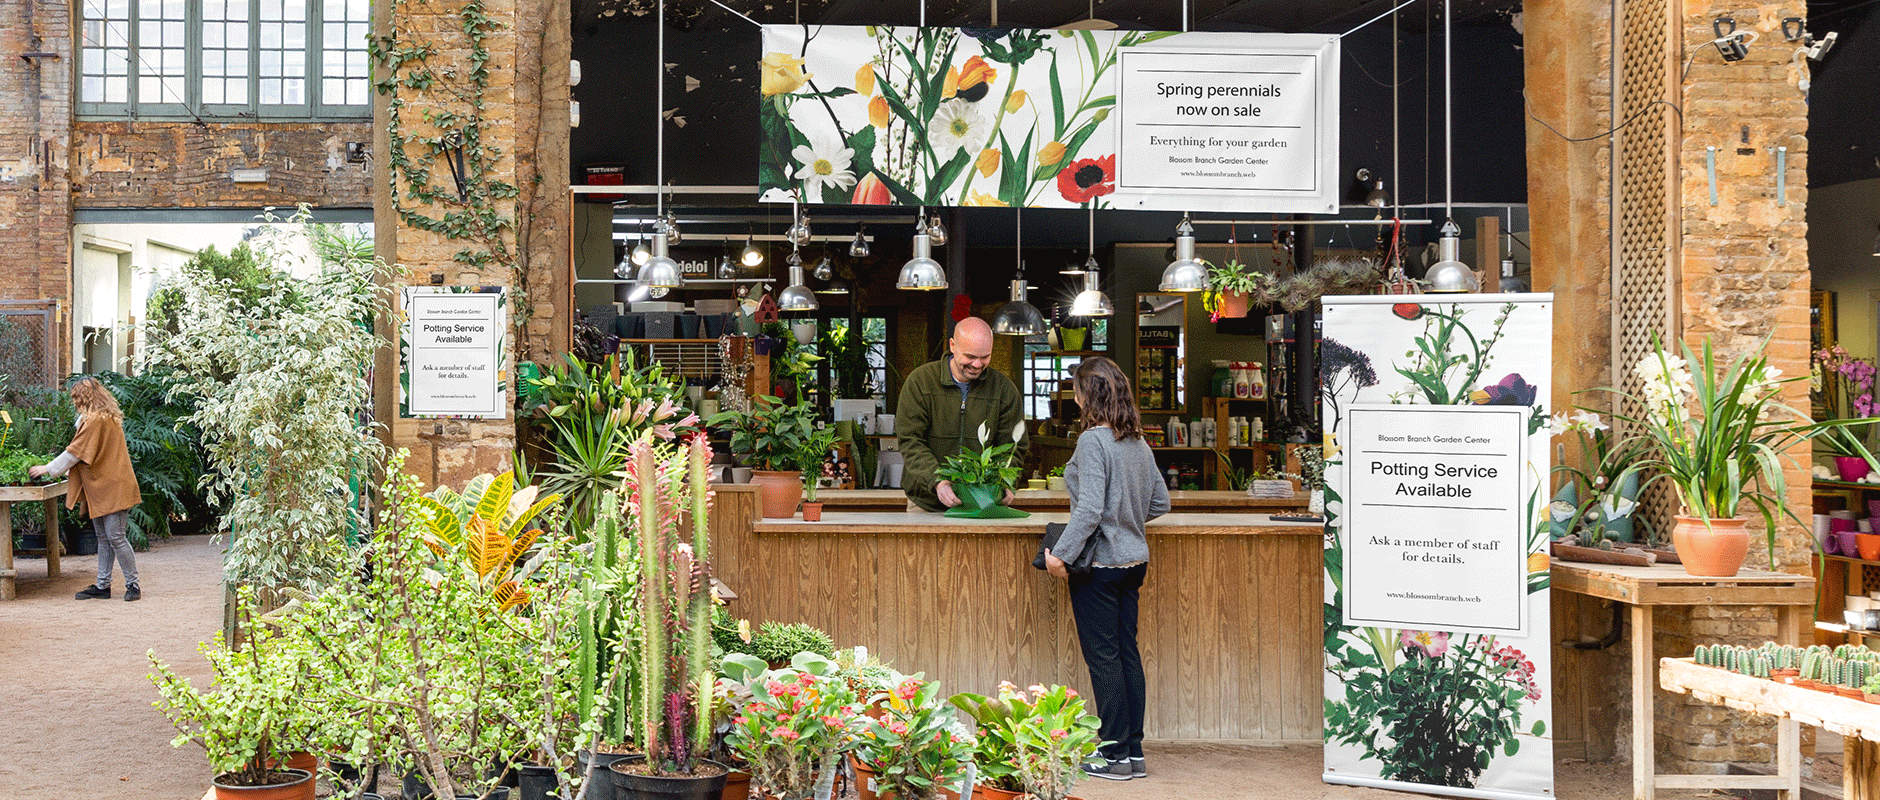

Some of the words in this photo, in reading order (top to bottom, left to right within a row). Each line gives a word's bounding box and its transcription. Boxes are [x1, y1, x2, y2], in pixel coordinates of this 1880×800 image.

[1156, 82, 1203, 99] Spring
[1207, 84, 1281, 99] perennials
[1176, 104, 1208, 116] now
[1211, 105, 1230, 116] on
[1233, 104, 1261, 117] sale
[1149, 135, 1206, 149] Everything
[1208, 137, 1224, 147] for
[1225, 140, 1249, 150] your
[1251, 138, 1288, 150] garden
[1168, 156, 1193, 164] Blossom
[1194, 156, 1217, 164] Branch
[1218, 157, 1244, 165] Garden
[1245, 158, 1269, 166] Center
[423, 324, 452, 334] Potting
[454, 324, 485, 333] Service
[435, 335, 473, 343] Available
[1378, 434, 1405, 442] Blossom
[1407, 435, 1431, 443] Branch
[1433, 435, 1462, 444] Garden
[1464, 436, 1491, 444] Center
[1371, 461, 1429, 479] Potting
[1433, 463, 1498, 478] Service
[1395, 483, 1472, 498] Available
[1369, 535, 1391, 546] Ask
[1393, 539, 1401, 547] a
[1404, 537, 1454, 549] member
[1456, 538, 1470, 549] of
[1471, 539, 1501, 551] staff
[1401, 551, 1418, 562] for
[1421, 551, 1465, 565] details.
[1386, 591, 1481, 603] www.blossombranch.web
